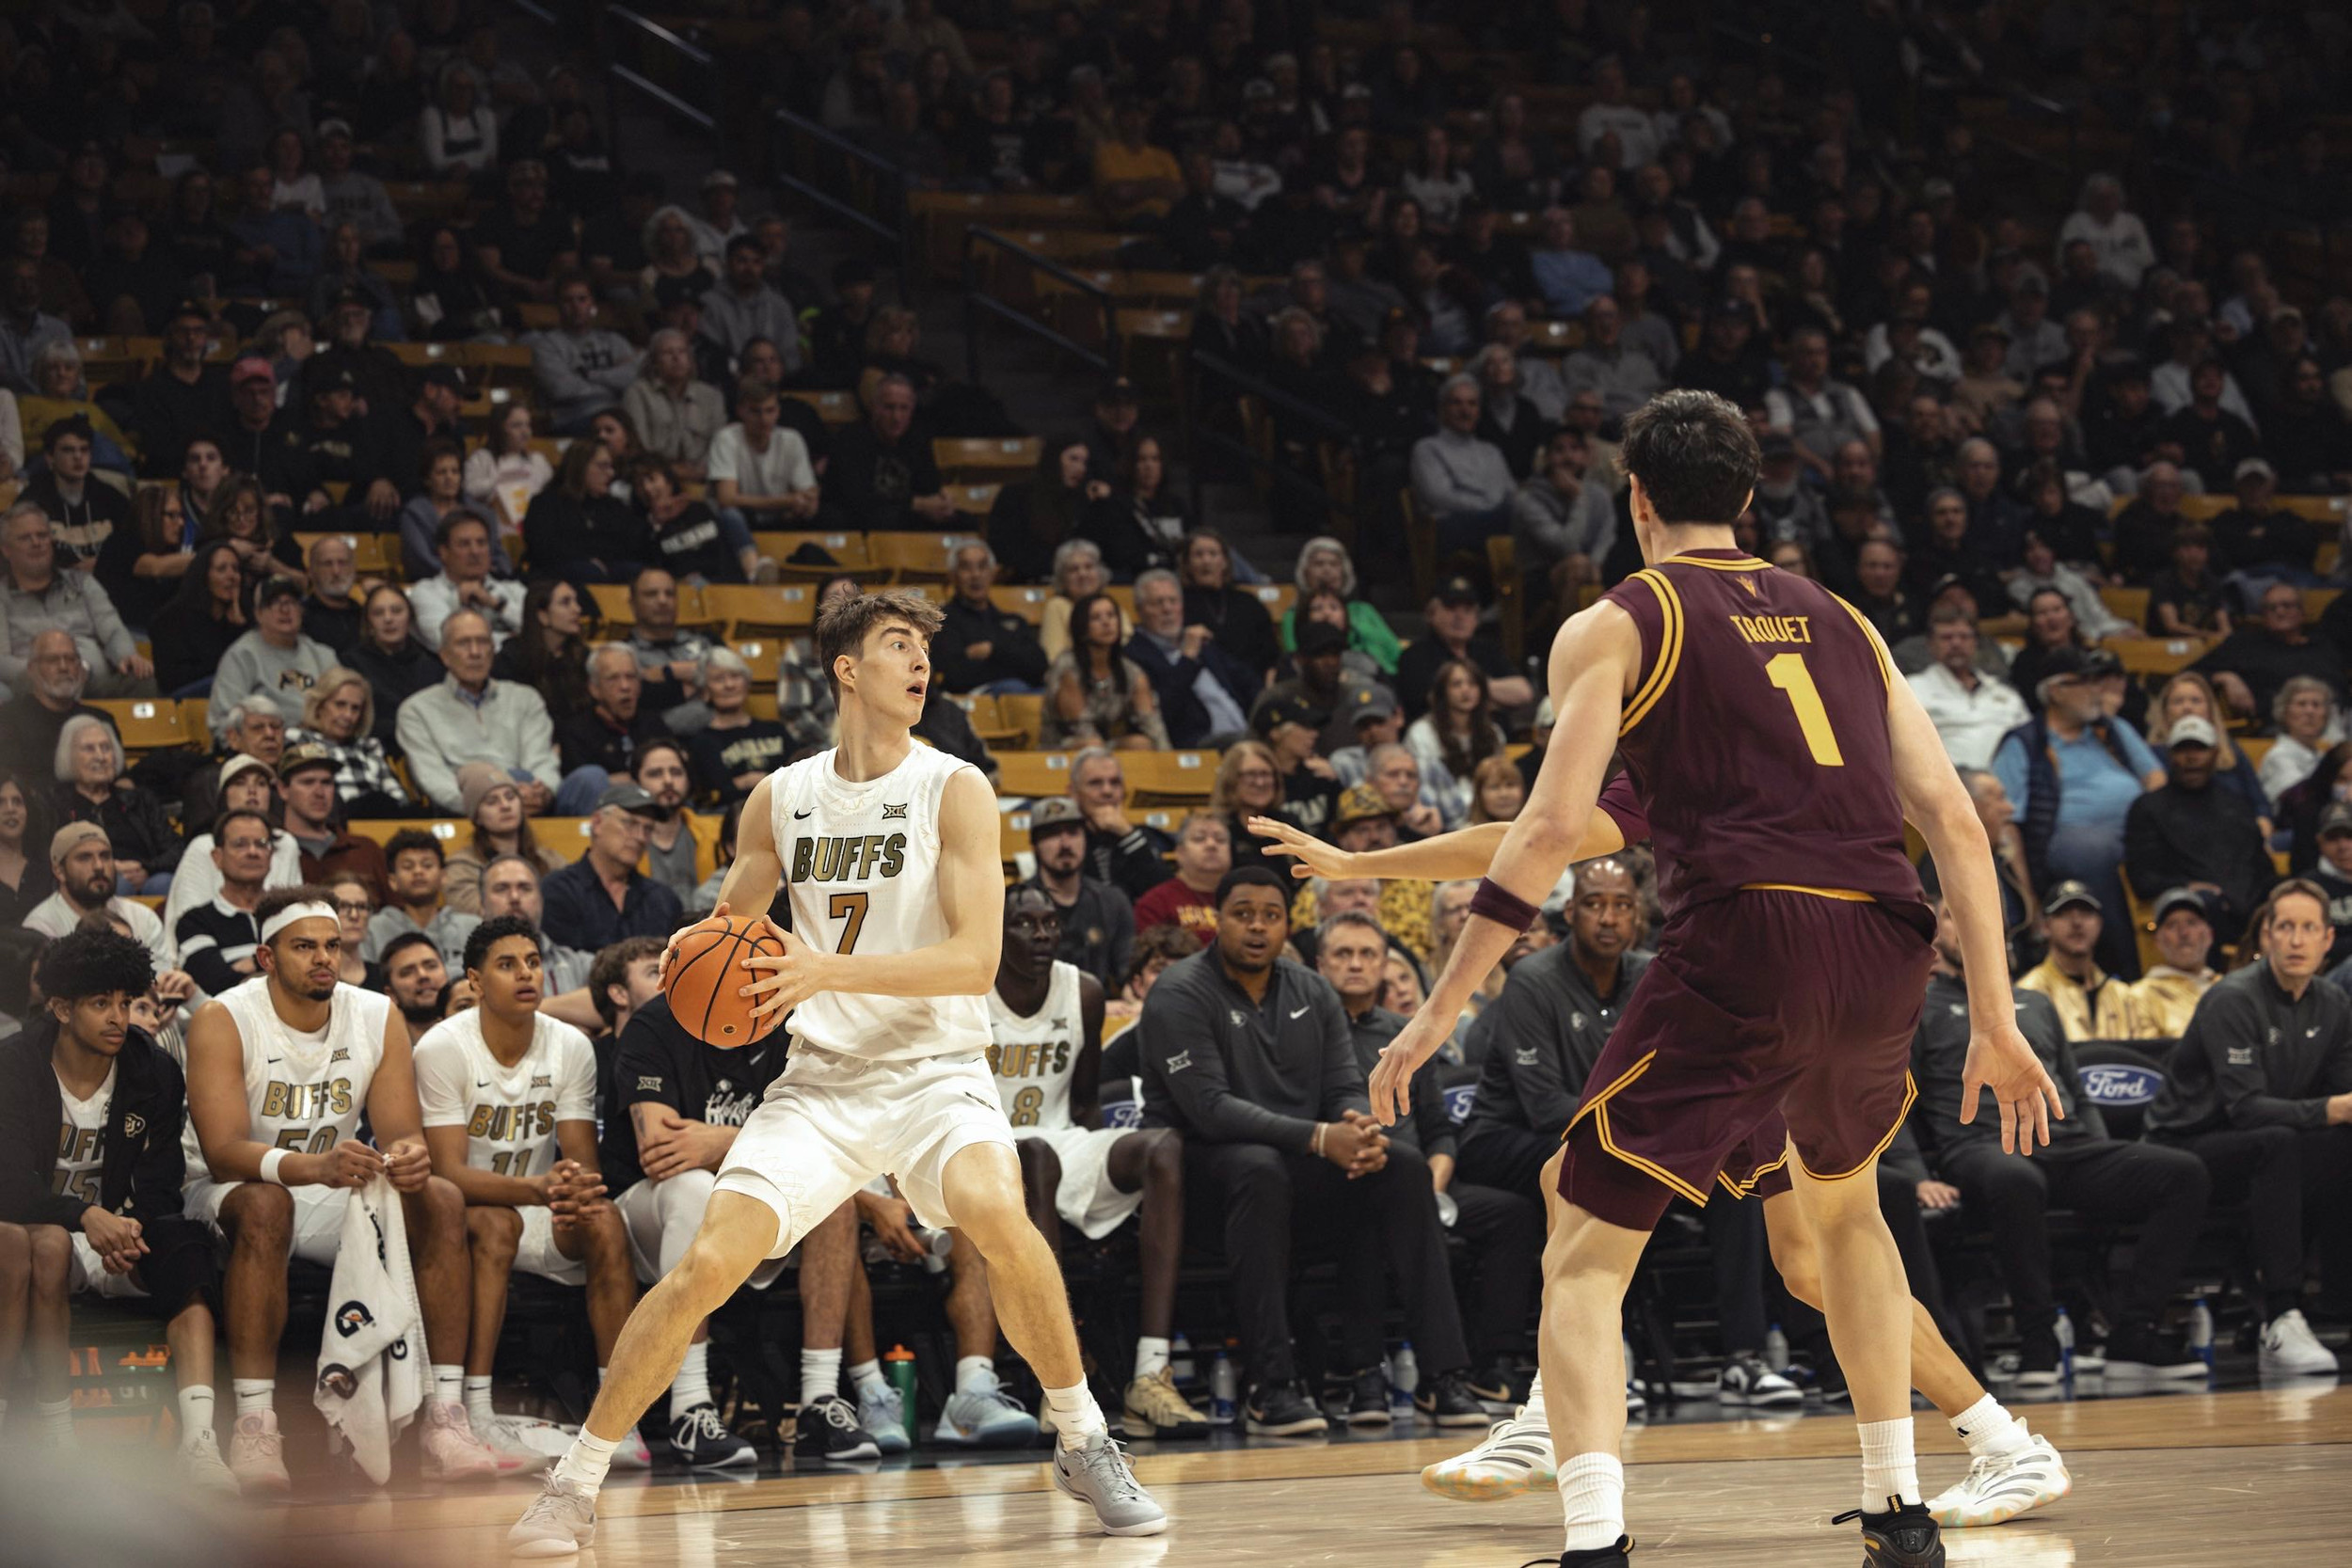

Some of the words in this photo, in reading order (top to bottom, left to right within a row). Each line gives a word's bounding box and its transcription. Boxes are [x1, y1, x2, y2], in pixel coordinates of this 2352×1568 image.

[1729, 615, 1812, 643] TROUET
[1765, 653, 1845, 767] 1
[791, 832, 907, 883] BUFFS
[829, 892, 869, 956] 7
[984, 1040, 1071, 1078] BUFFS
[262, 1077, 353, 1120] BUFFS
[2085, 1071, 2149, 1099] Ford
[467, 1101, 557, 1141] BUFFS
[1010, 1085, 1043, 1128] 8
[492, 1148, 532, 1177] 11
